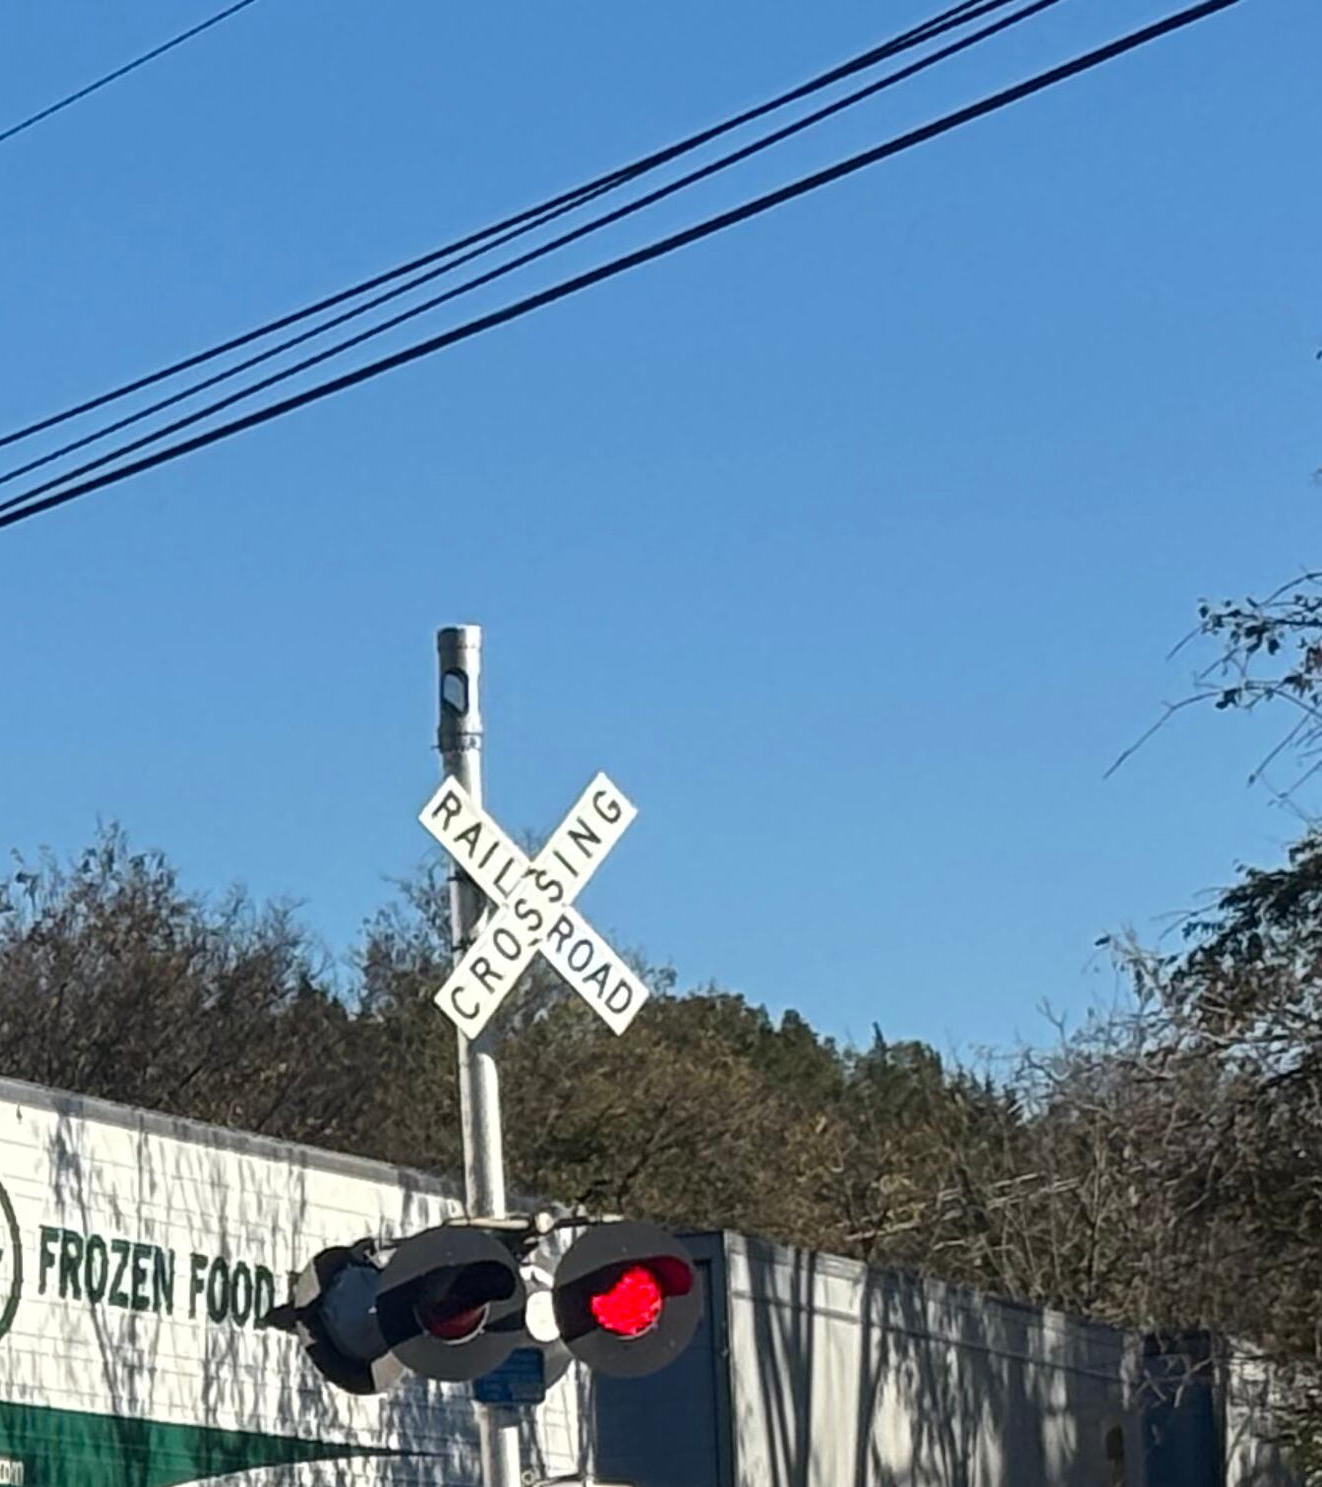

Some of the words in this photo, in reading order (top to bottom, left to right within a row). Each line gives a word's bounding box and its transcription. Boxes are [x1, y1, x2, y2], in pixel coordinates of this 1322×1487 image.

[431, 789, 516, 900] RAIL
[546, 913, 634, 1015] ROAD
[450, 789, 622, 1021] CROSSING
[38, 1223, 176, 1318] FROZEN
[189, 1250, 276, 1330] FOOD
